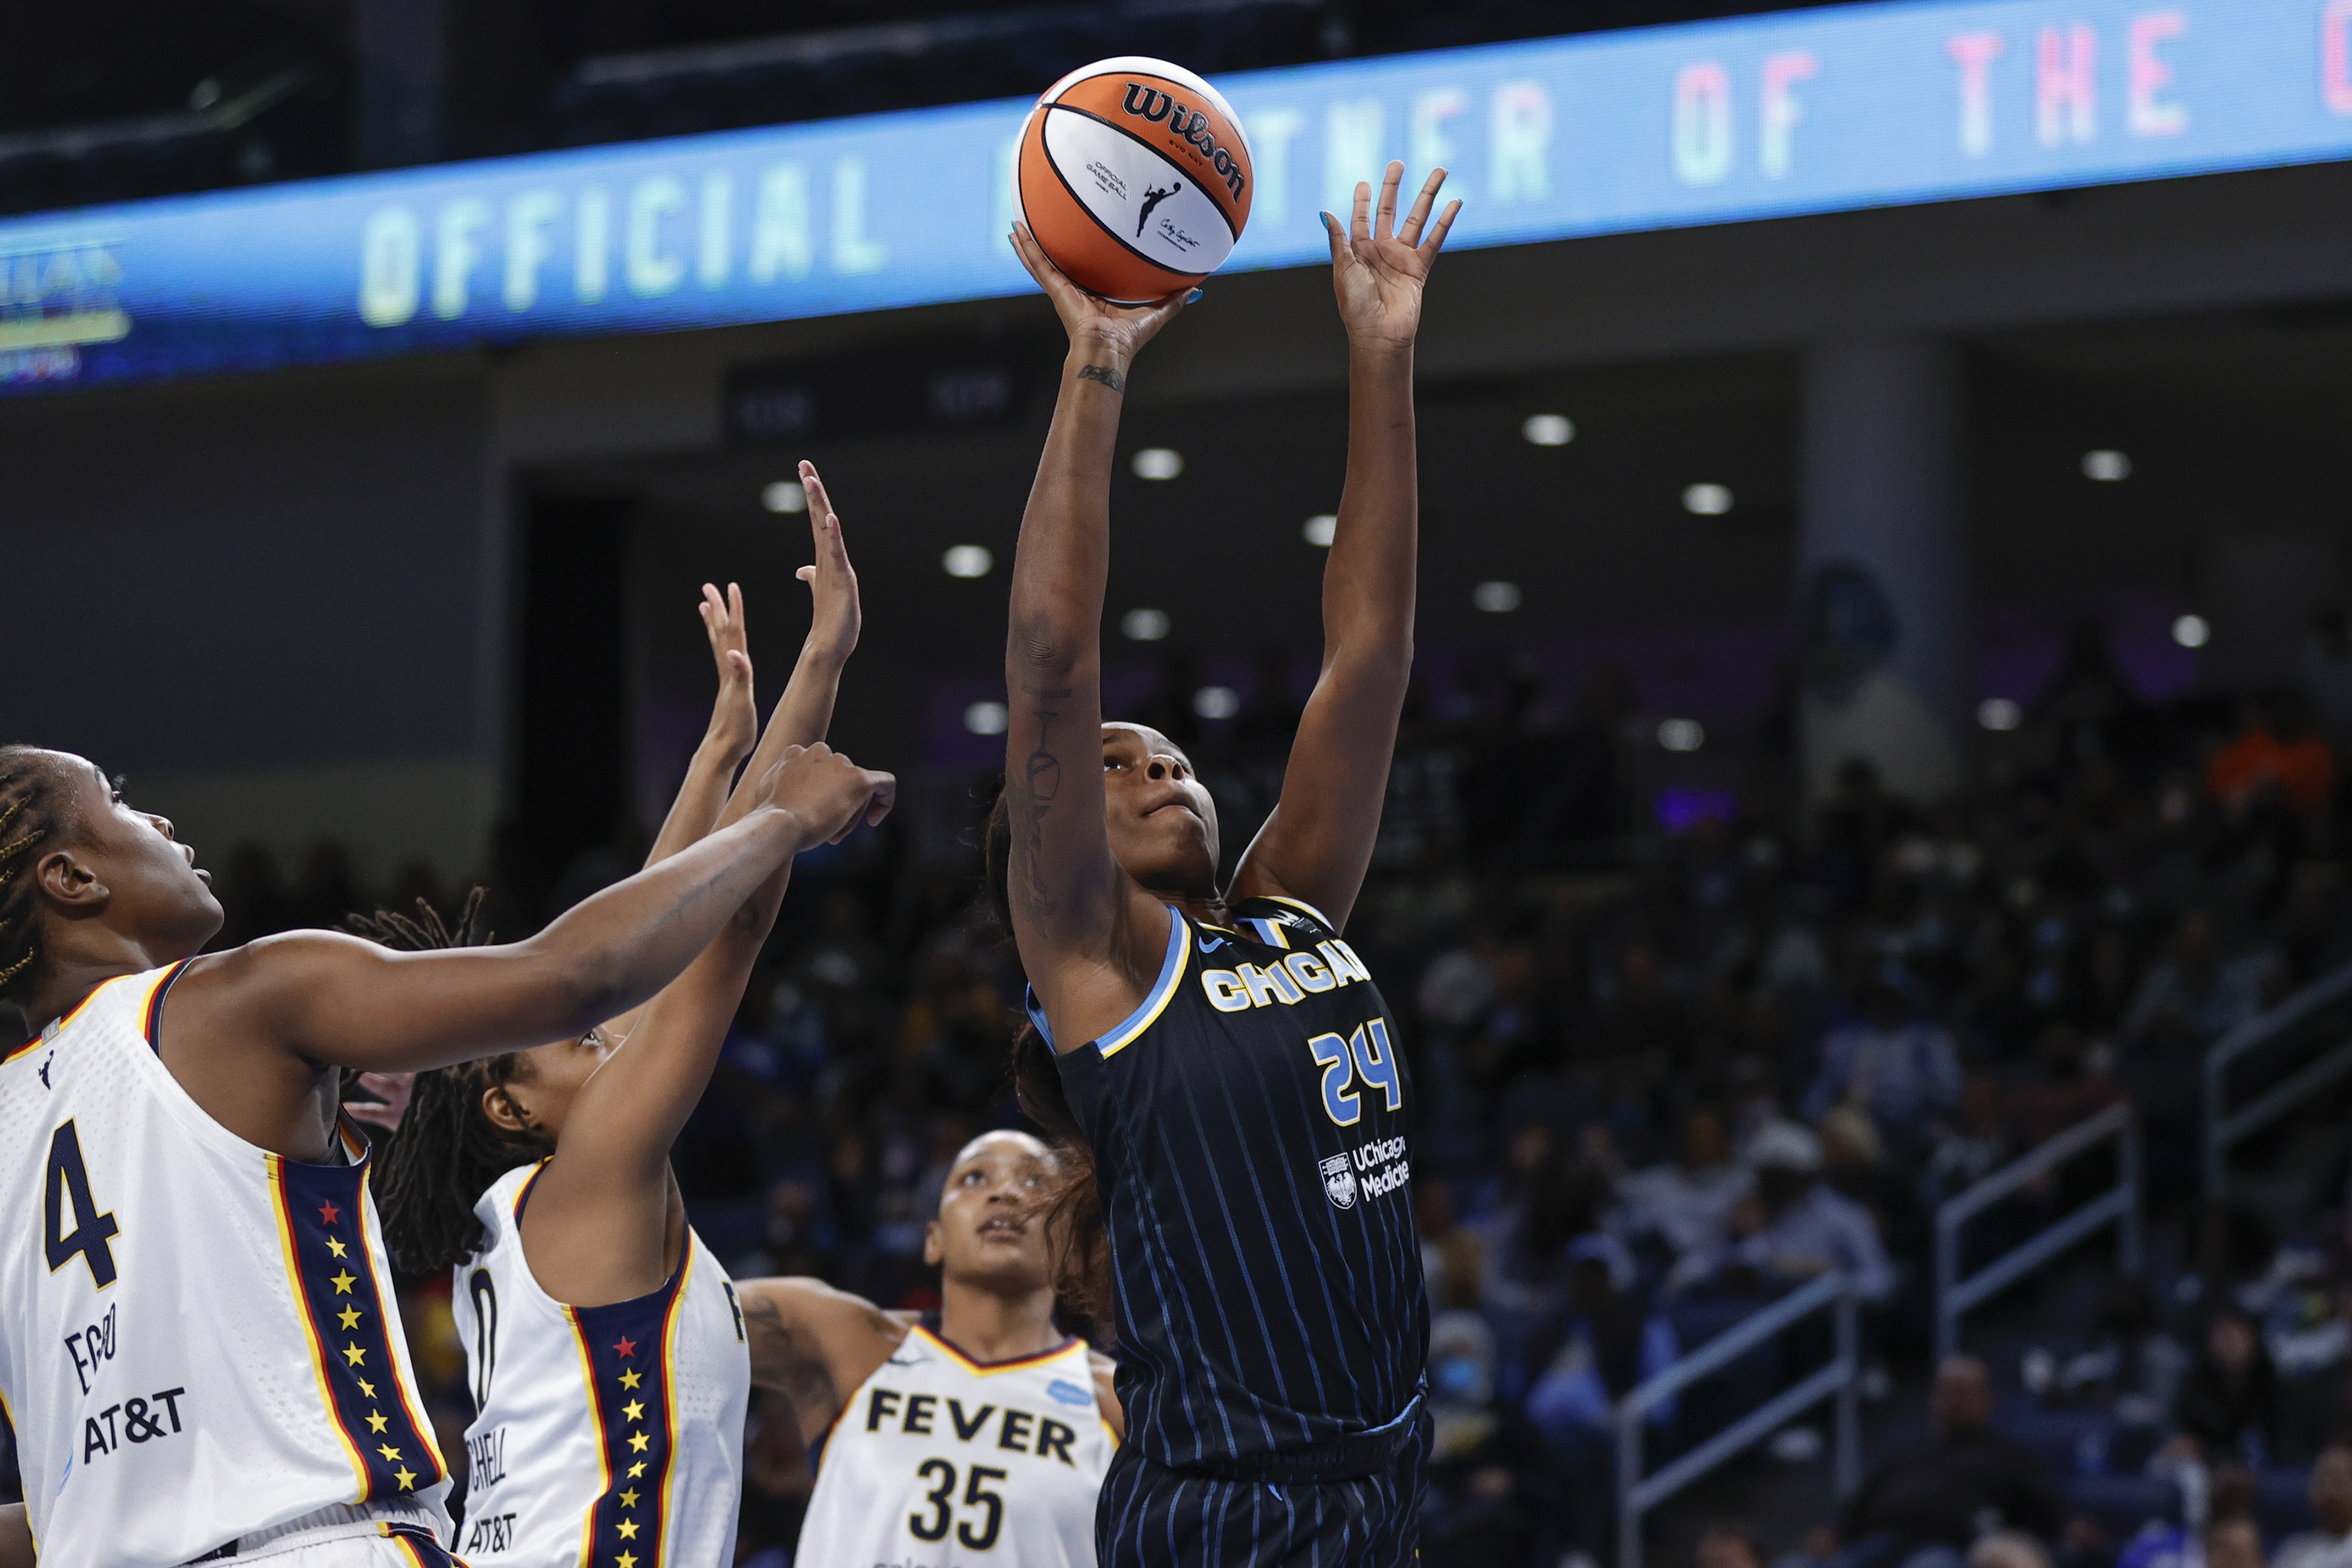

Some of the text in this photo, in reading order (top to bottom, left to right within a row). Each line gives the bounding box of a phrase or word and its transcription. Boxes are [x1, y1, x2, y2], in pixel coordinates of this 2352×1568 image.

[359, 153, 889, 329] OFFICIAL
[1673, 50, 1819, 187] OF
[1940, 11, 2190, 159] THE
[1095, 162, 1127, 191] OFFICIAL
[1122, 81, 1245, 203] Wilson
[1087, 163, 1127, 201] GAME BALL
[1307, 1017, 1402, 1128] 24
[44, 1116, 121, 1292] 4
[1360, 1161, 1409, 1202] Medicne
[84, 1386, 185, 1465] AT&T
[466, 1427, 506, 1492] CHELL
[866, 1388, 1076, 1466] FEVER
[464, 1512, 517, 1556] AT&T
[909, 1458, 1007, 1551] 35
